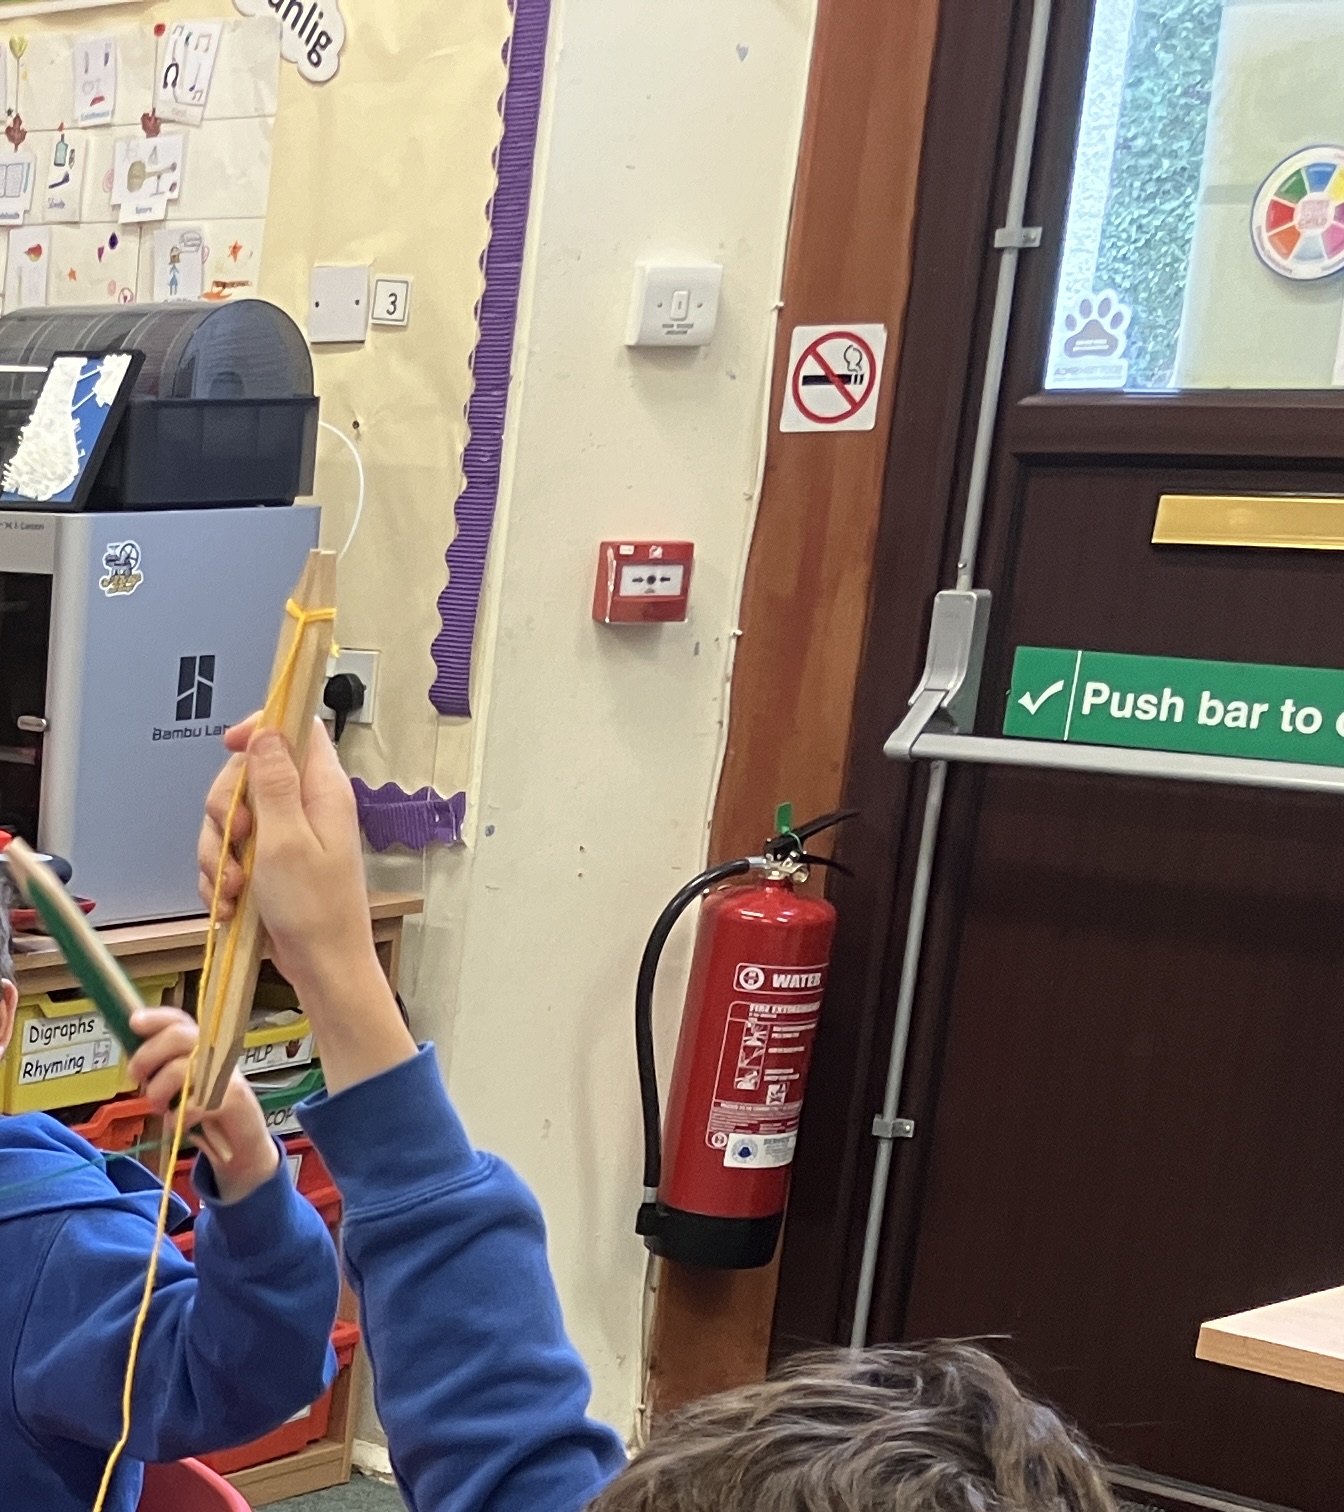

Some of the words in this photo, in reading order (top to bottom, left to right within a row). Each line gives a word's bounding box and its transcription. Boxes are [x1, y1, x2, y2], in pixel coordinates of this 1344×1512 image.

[385, 292, 398, 316] 3
[1081, 680, 1186, 724] Push
[1197, 690, 1270, 730] bar
[1280, 697, 1324, 736] to
[152, 726, 202, 742] Bambu
[772, 972, 822, 989] WATER
[28, 1016, 95, 1046] Digraphs
[22, 1053, 85, 1081] Rhyming
[244, 1044, 274, 1066] HLP
